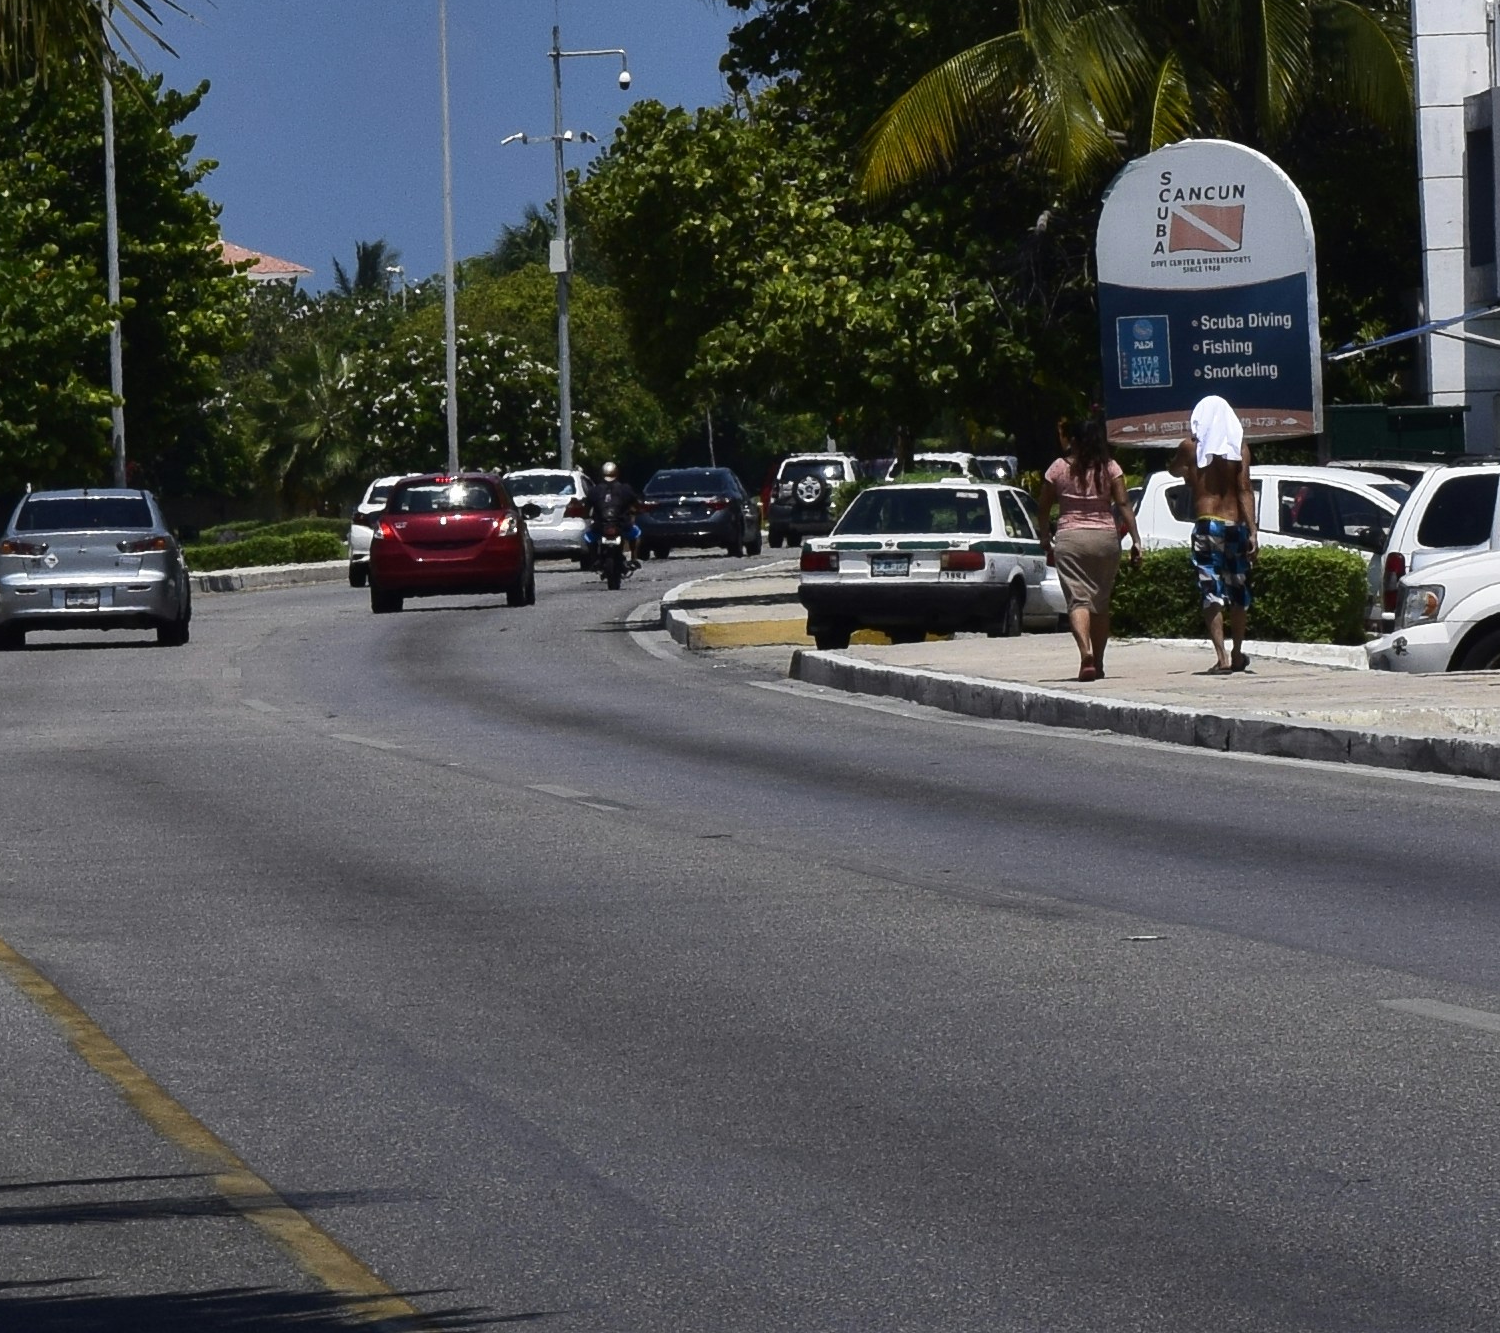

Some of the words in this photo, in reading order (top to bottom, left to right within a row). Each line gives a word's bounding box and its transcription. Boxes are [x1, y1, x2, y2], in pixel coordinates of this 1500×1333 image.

[1159, 184, 1245, 203] CANCUN
[1153, 171, 1172, 255] SCUBA
[1201, 314, 1244, 330] Scuba
[1248, 312, 1292, 329] Diving
[1202, 339, 1253, 355] Fishing
[1204, 363, 1278, 379] Snorkeling
